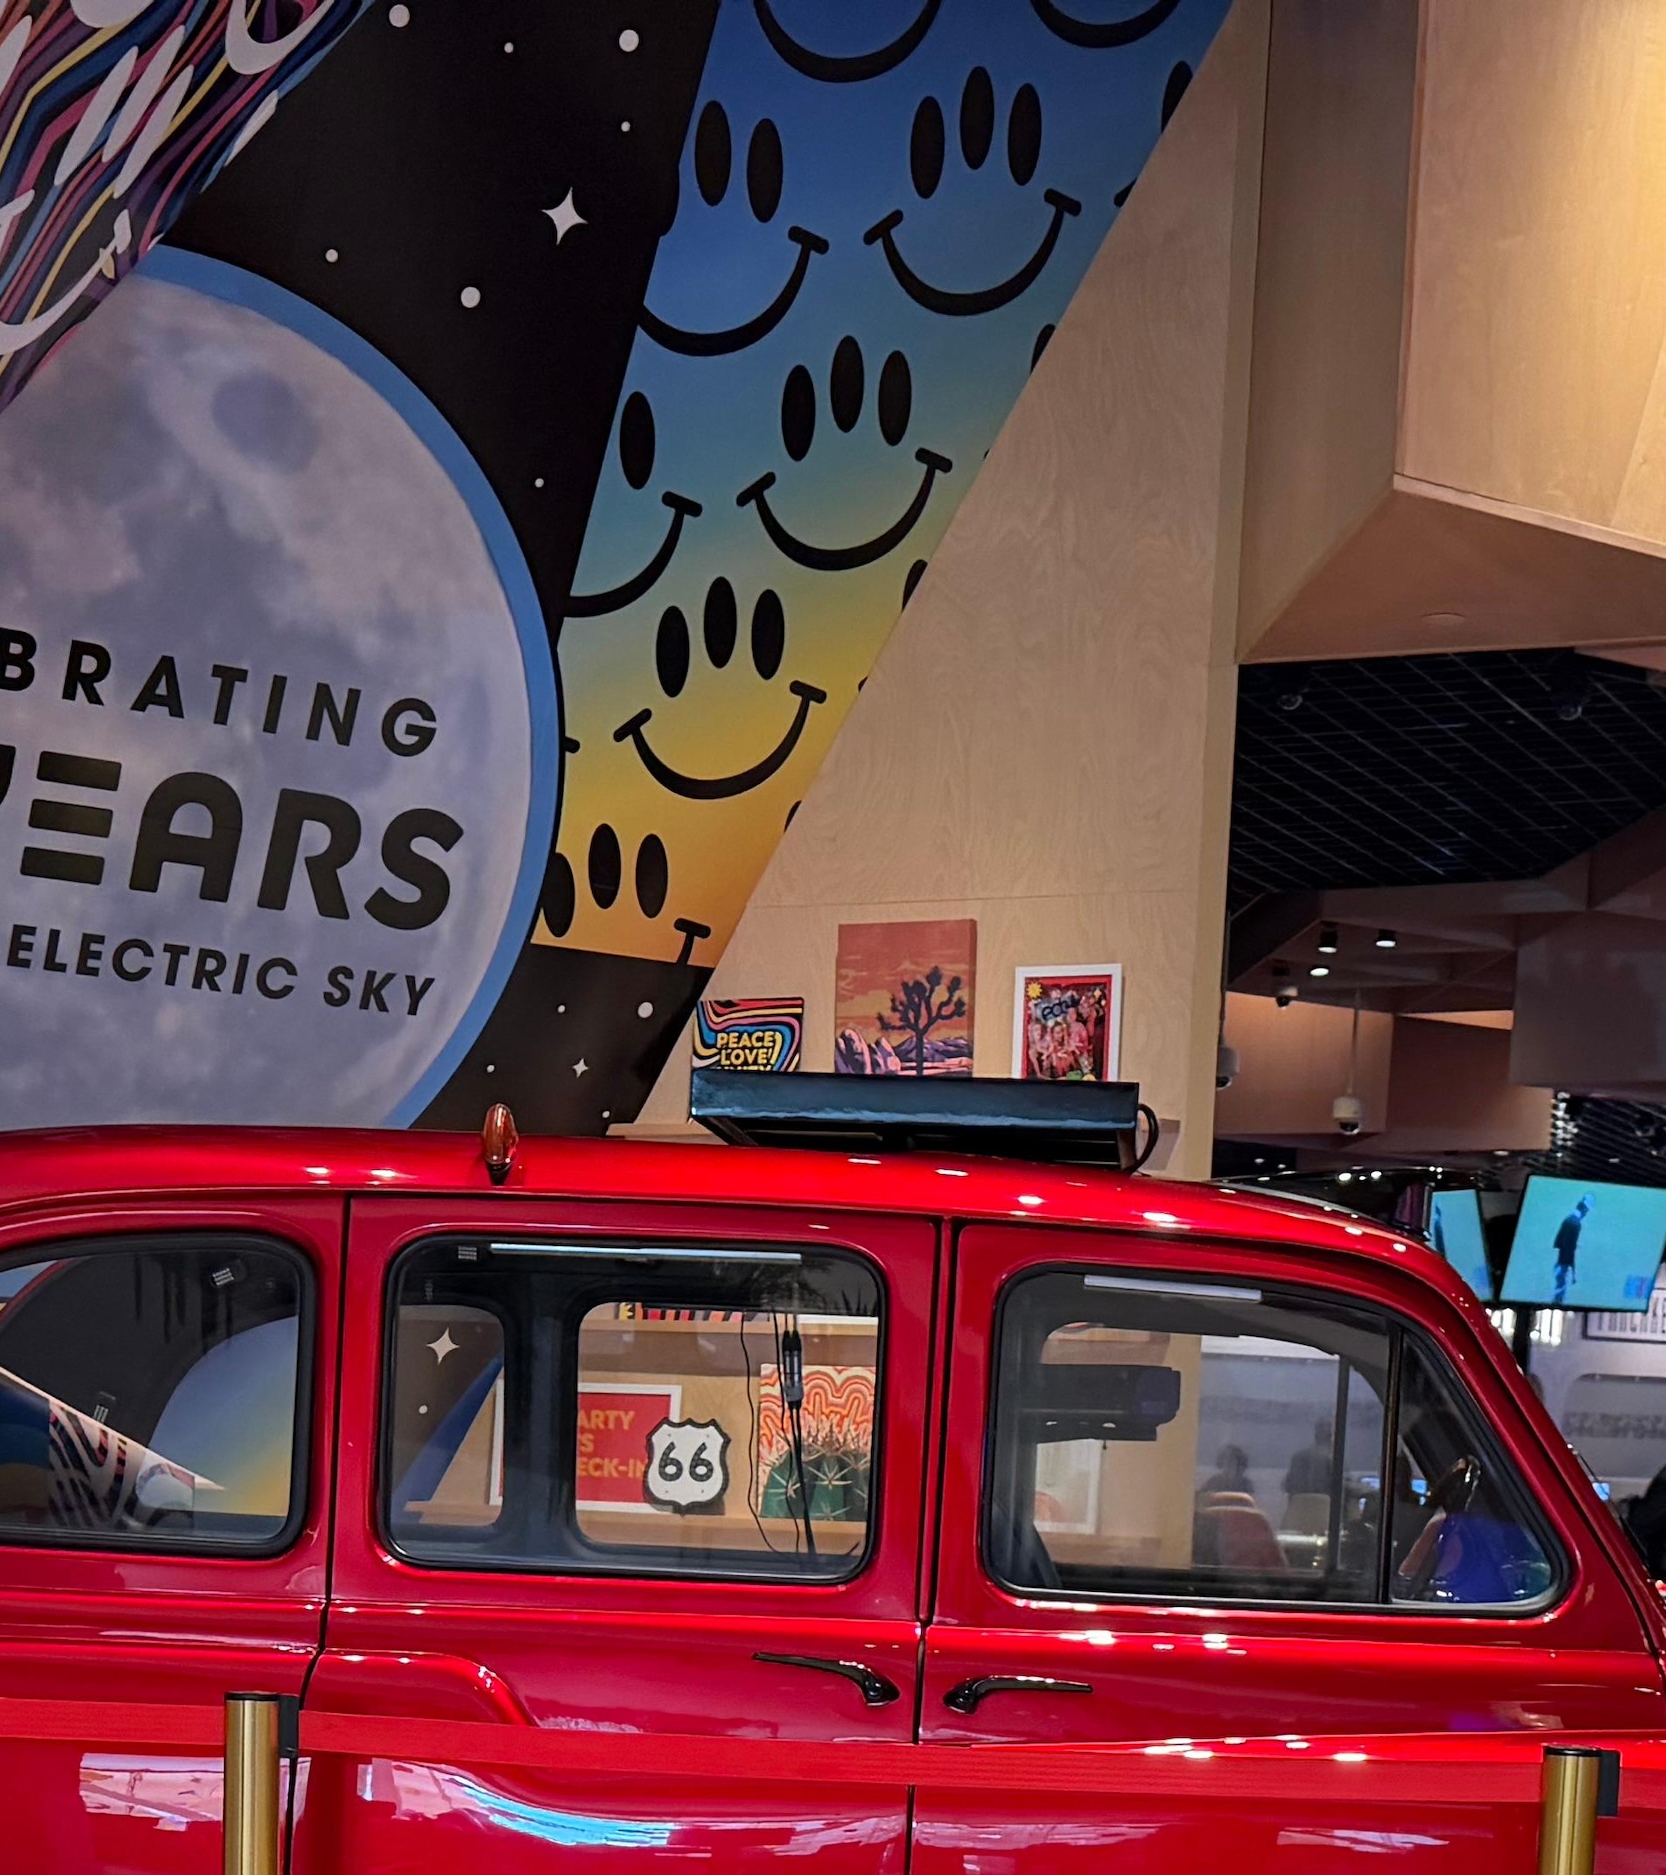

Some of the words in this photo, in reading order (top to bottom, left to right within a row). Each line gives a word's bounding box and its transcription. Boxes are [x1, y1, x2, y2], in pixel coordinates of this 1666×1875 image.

[6, 923, 299, 1001] ELECTRIC
[322, 964, 438, 1017] SKY
[716, 1031, 775, 1048] PEACE
[579, 1409, 636, 1431] ARTY
[657, 1441, 715, 1483] 66
